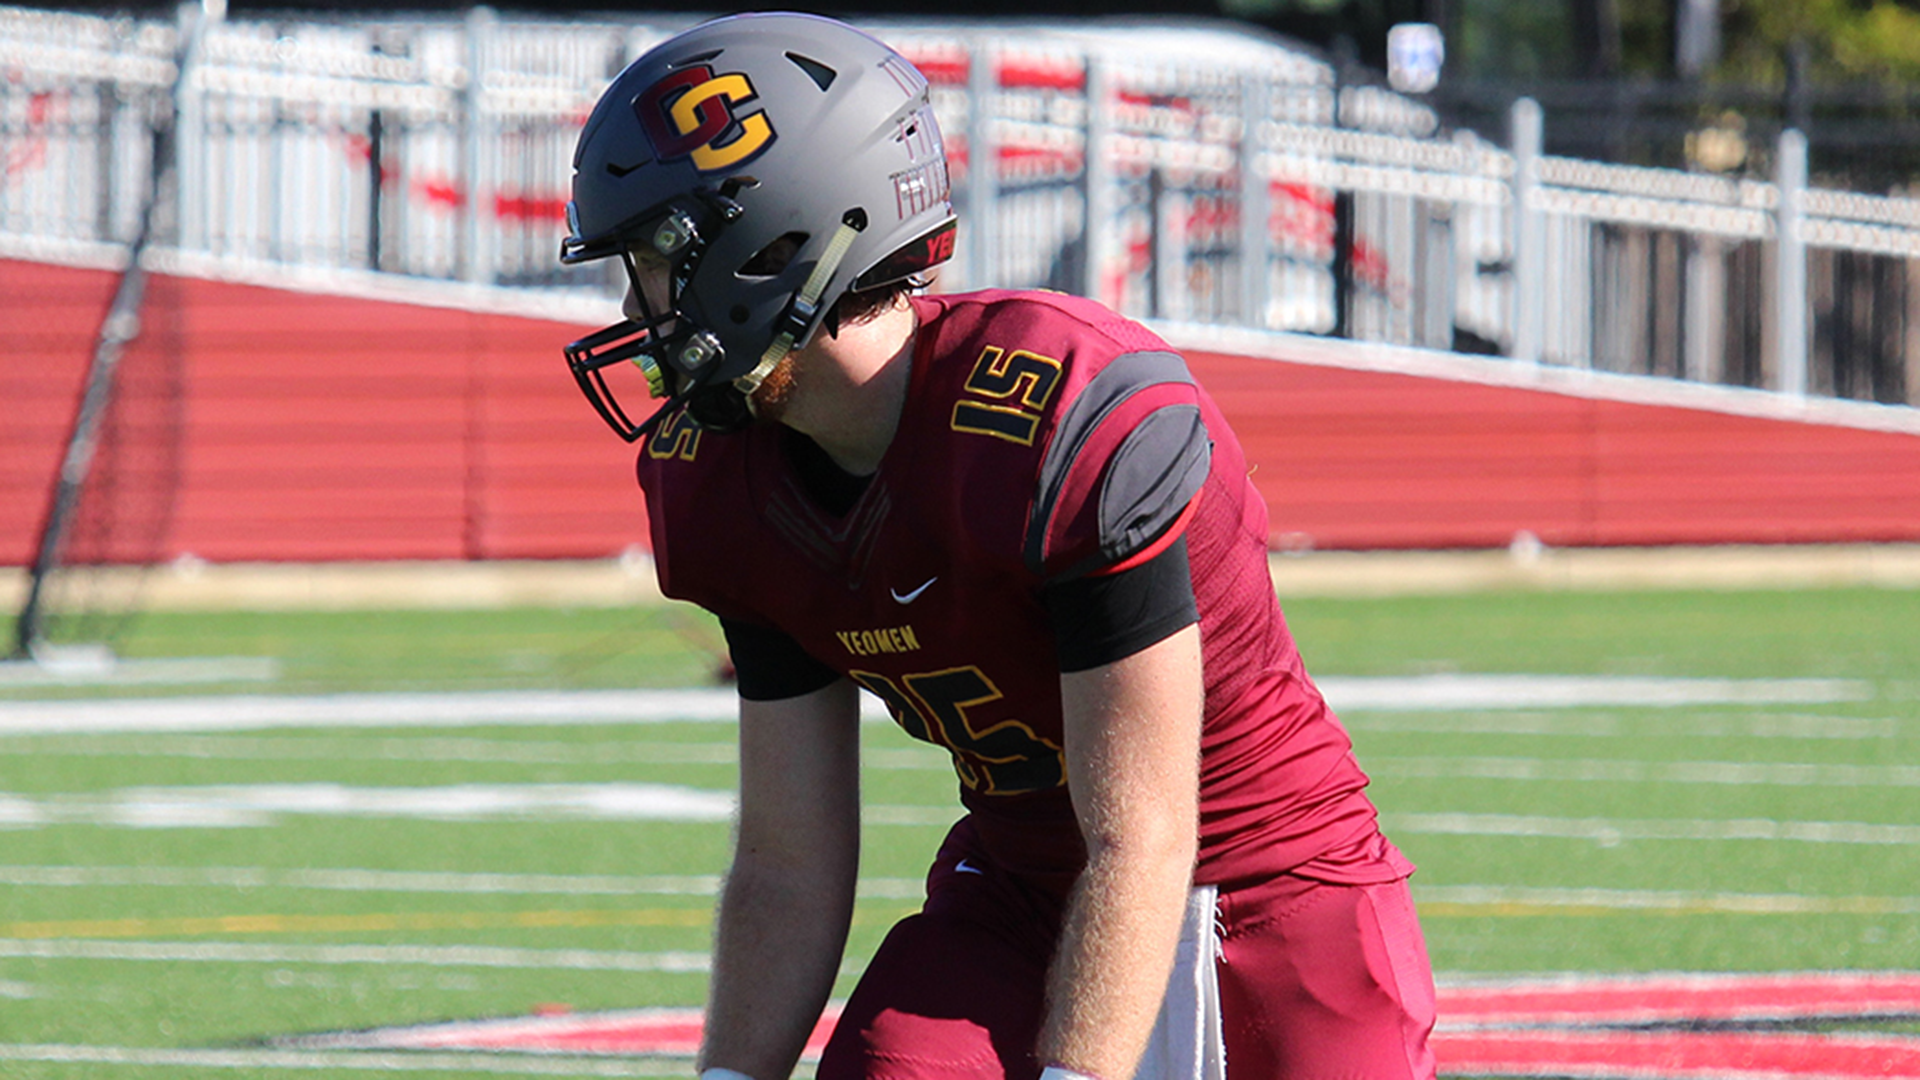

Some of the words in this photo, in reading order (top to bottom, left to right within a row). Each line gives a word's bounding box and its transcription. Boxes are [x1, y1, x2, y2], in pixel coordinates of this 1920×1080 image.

[926, 227, 957, 264] YE
[950, 345, 1062, 446] 15
[836, 625, 921, 656] YEOMEN
